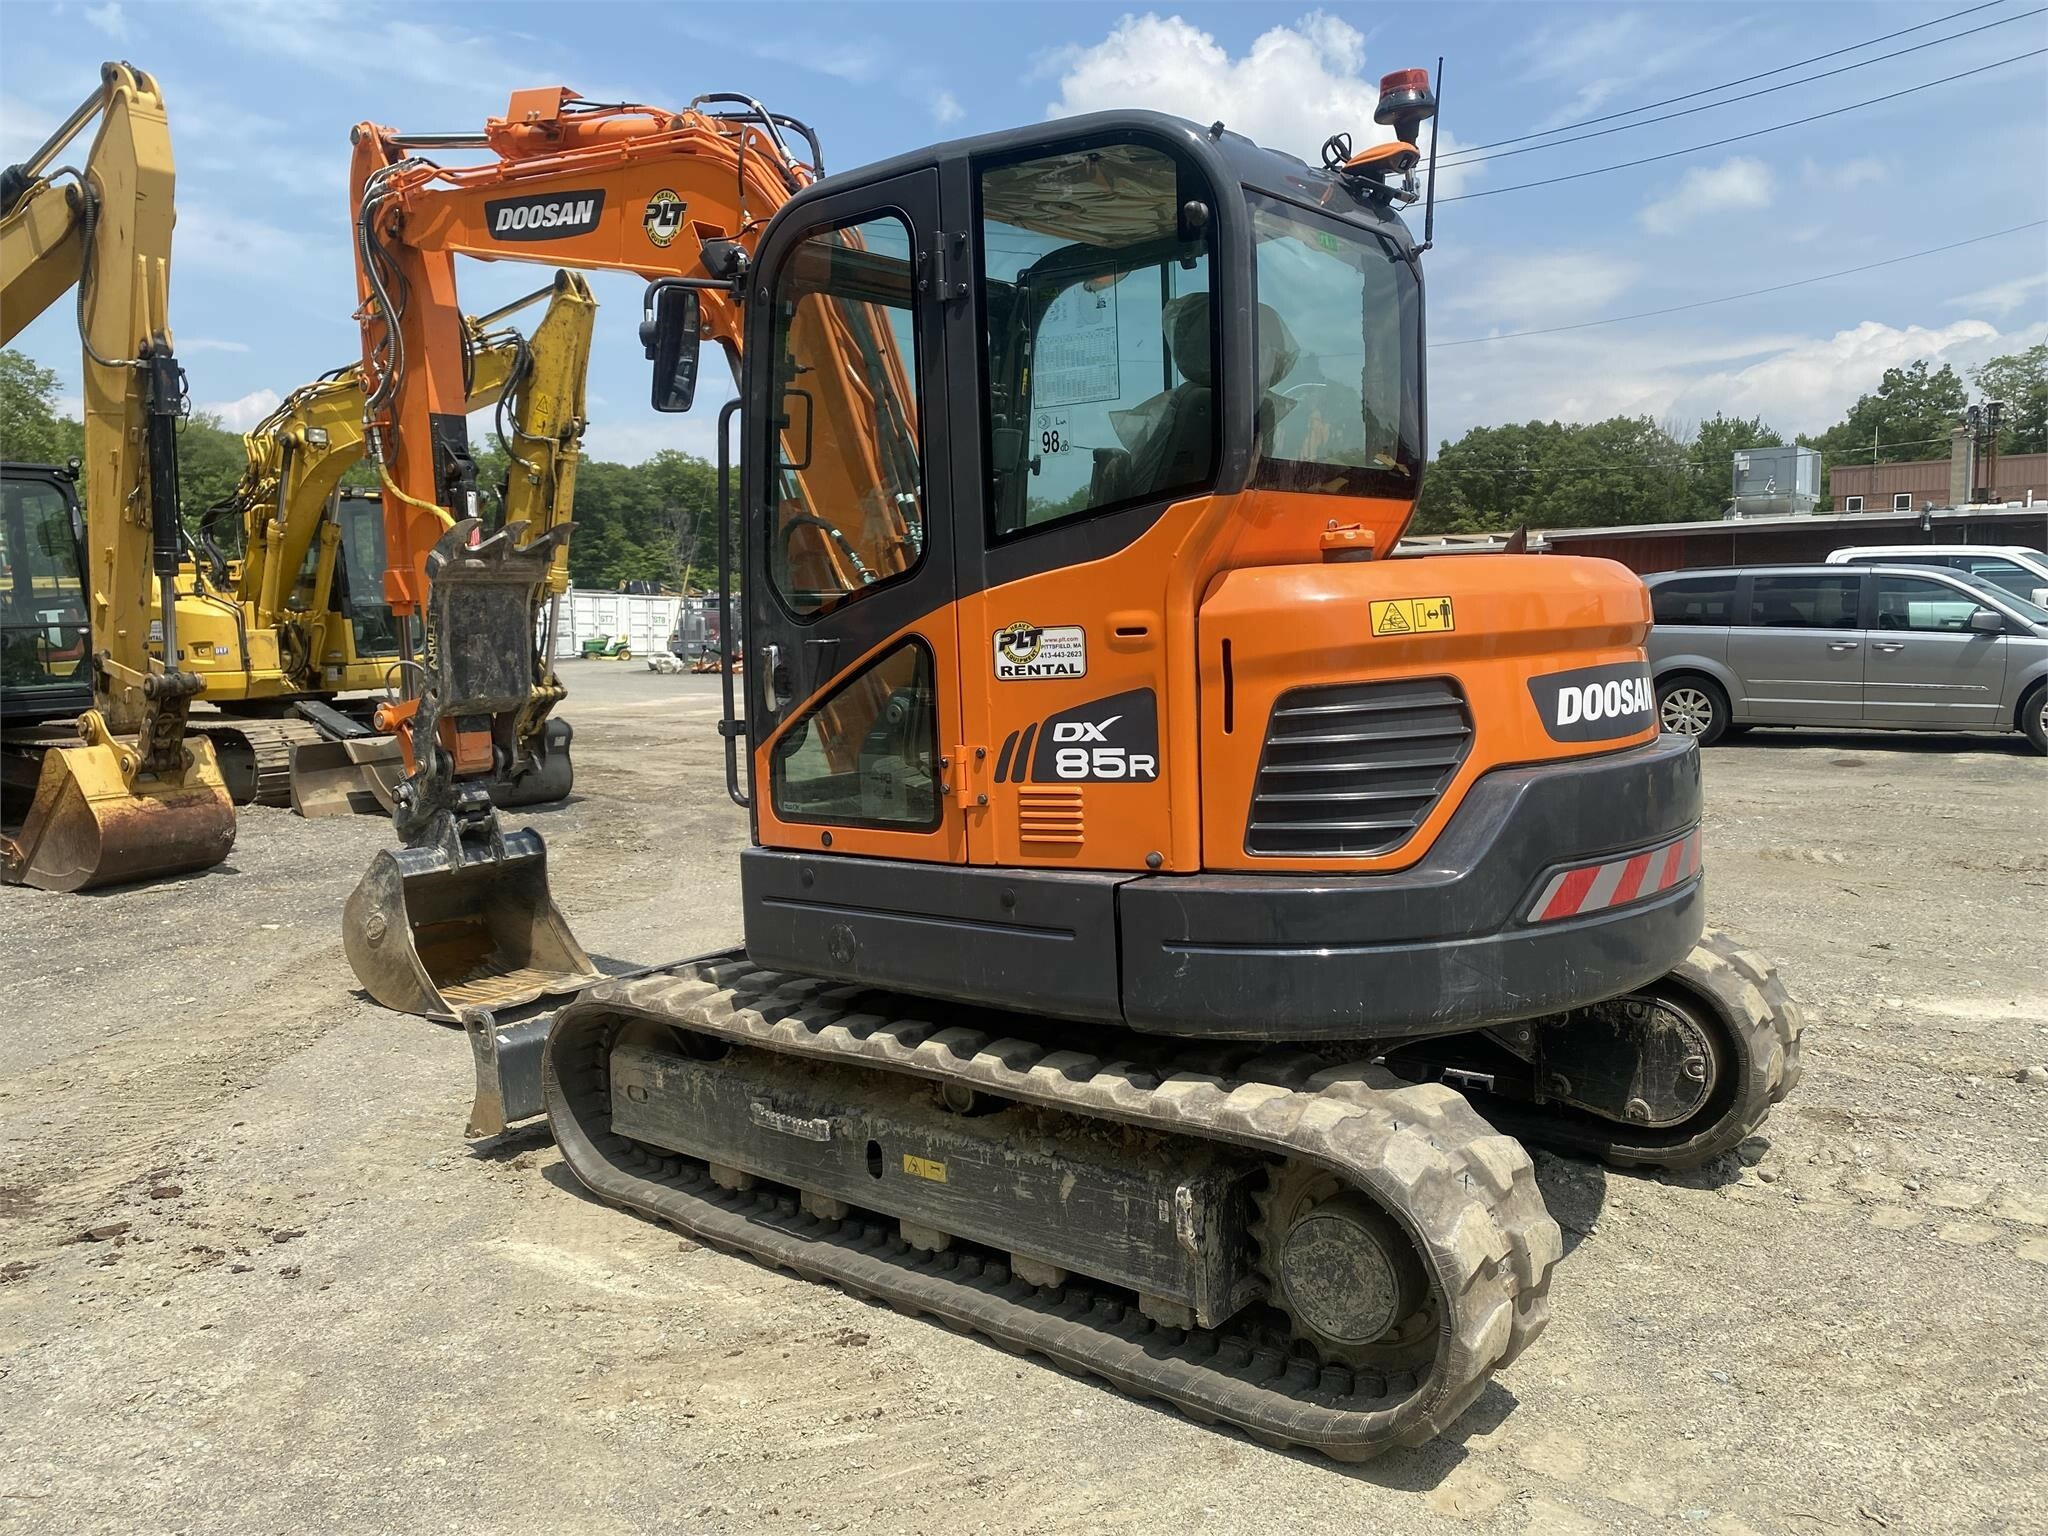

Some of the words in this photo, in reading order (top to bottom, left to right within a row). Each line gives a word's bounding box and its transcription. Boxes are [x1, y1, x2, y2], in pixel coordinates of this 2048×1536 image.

[495, 200, 595, 231] DOOSAN
[642, 202, 688, 227] PLT
[1042, 430, 1060, 454] 98
[999, 629, 1043, 652] PLT
[1006, 649, 1038, 663] EQUIPMENT
[1040, 651, 1082, 659] 413-443-2623
[1001, 663, 1081, 676] RENTAL
[1557, 677, 1653, 725] DOOSAN
[1053, 715, 1123, 742] DX
[1055, 747, 1156, 779] 85R
